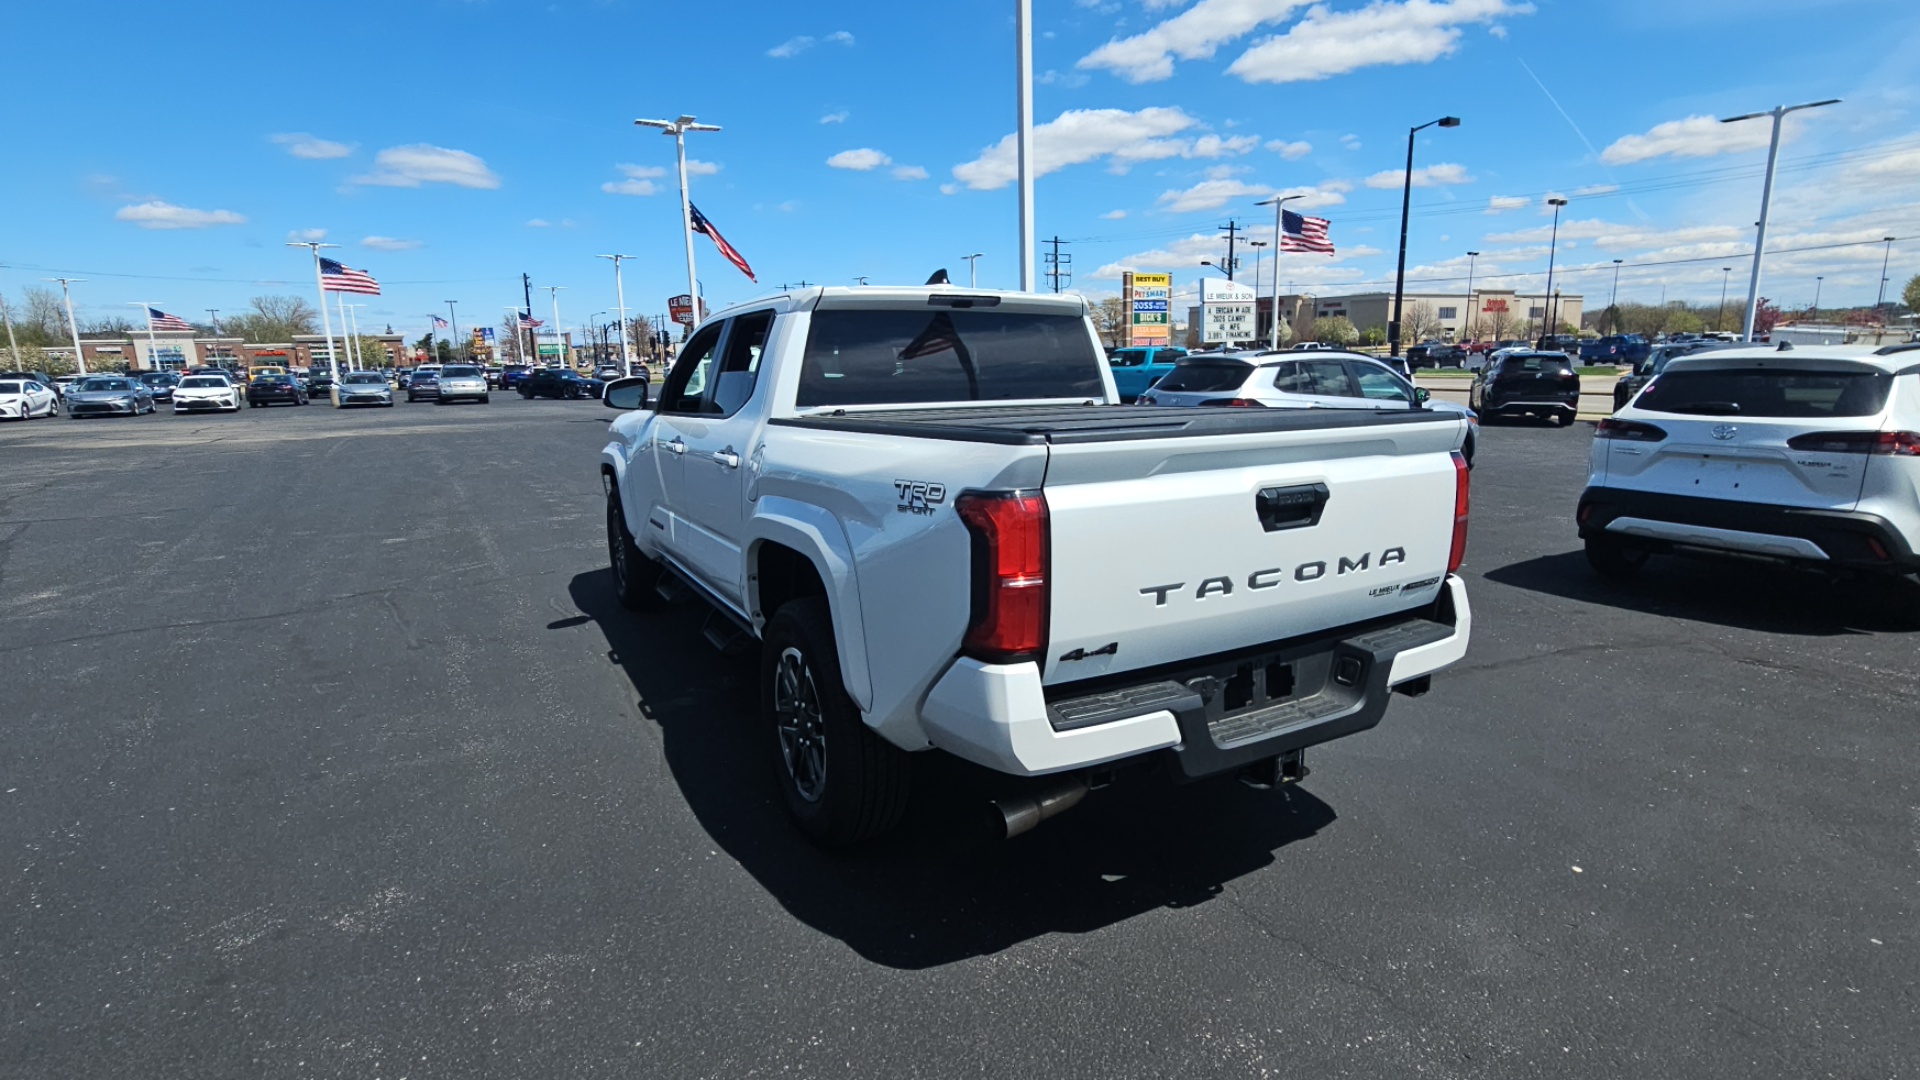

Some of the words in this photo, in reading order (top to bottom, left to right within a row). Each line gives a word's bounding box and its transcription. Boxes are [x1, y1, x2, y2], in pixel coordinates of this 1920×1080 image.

[670, 298, 678, 306] LE
[679, 297, 693, 306] MIE
[1134, 301, 1153, 309] ROSS
[1226, 331, 1251, 339] FINANCING
[894, 478, 946, 507] TRD
[1279, 493, 1315, 505] TOYOTA
[897, 504, 937, 517] SPORT
[1138, 545, 1407, 608] TACOMA
[1368, 588, 1378, 596] LE
[1378, 583, 1401, 594] MIEUX
